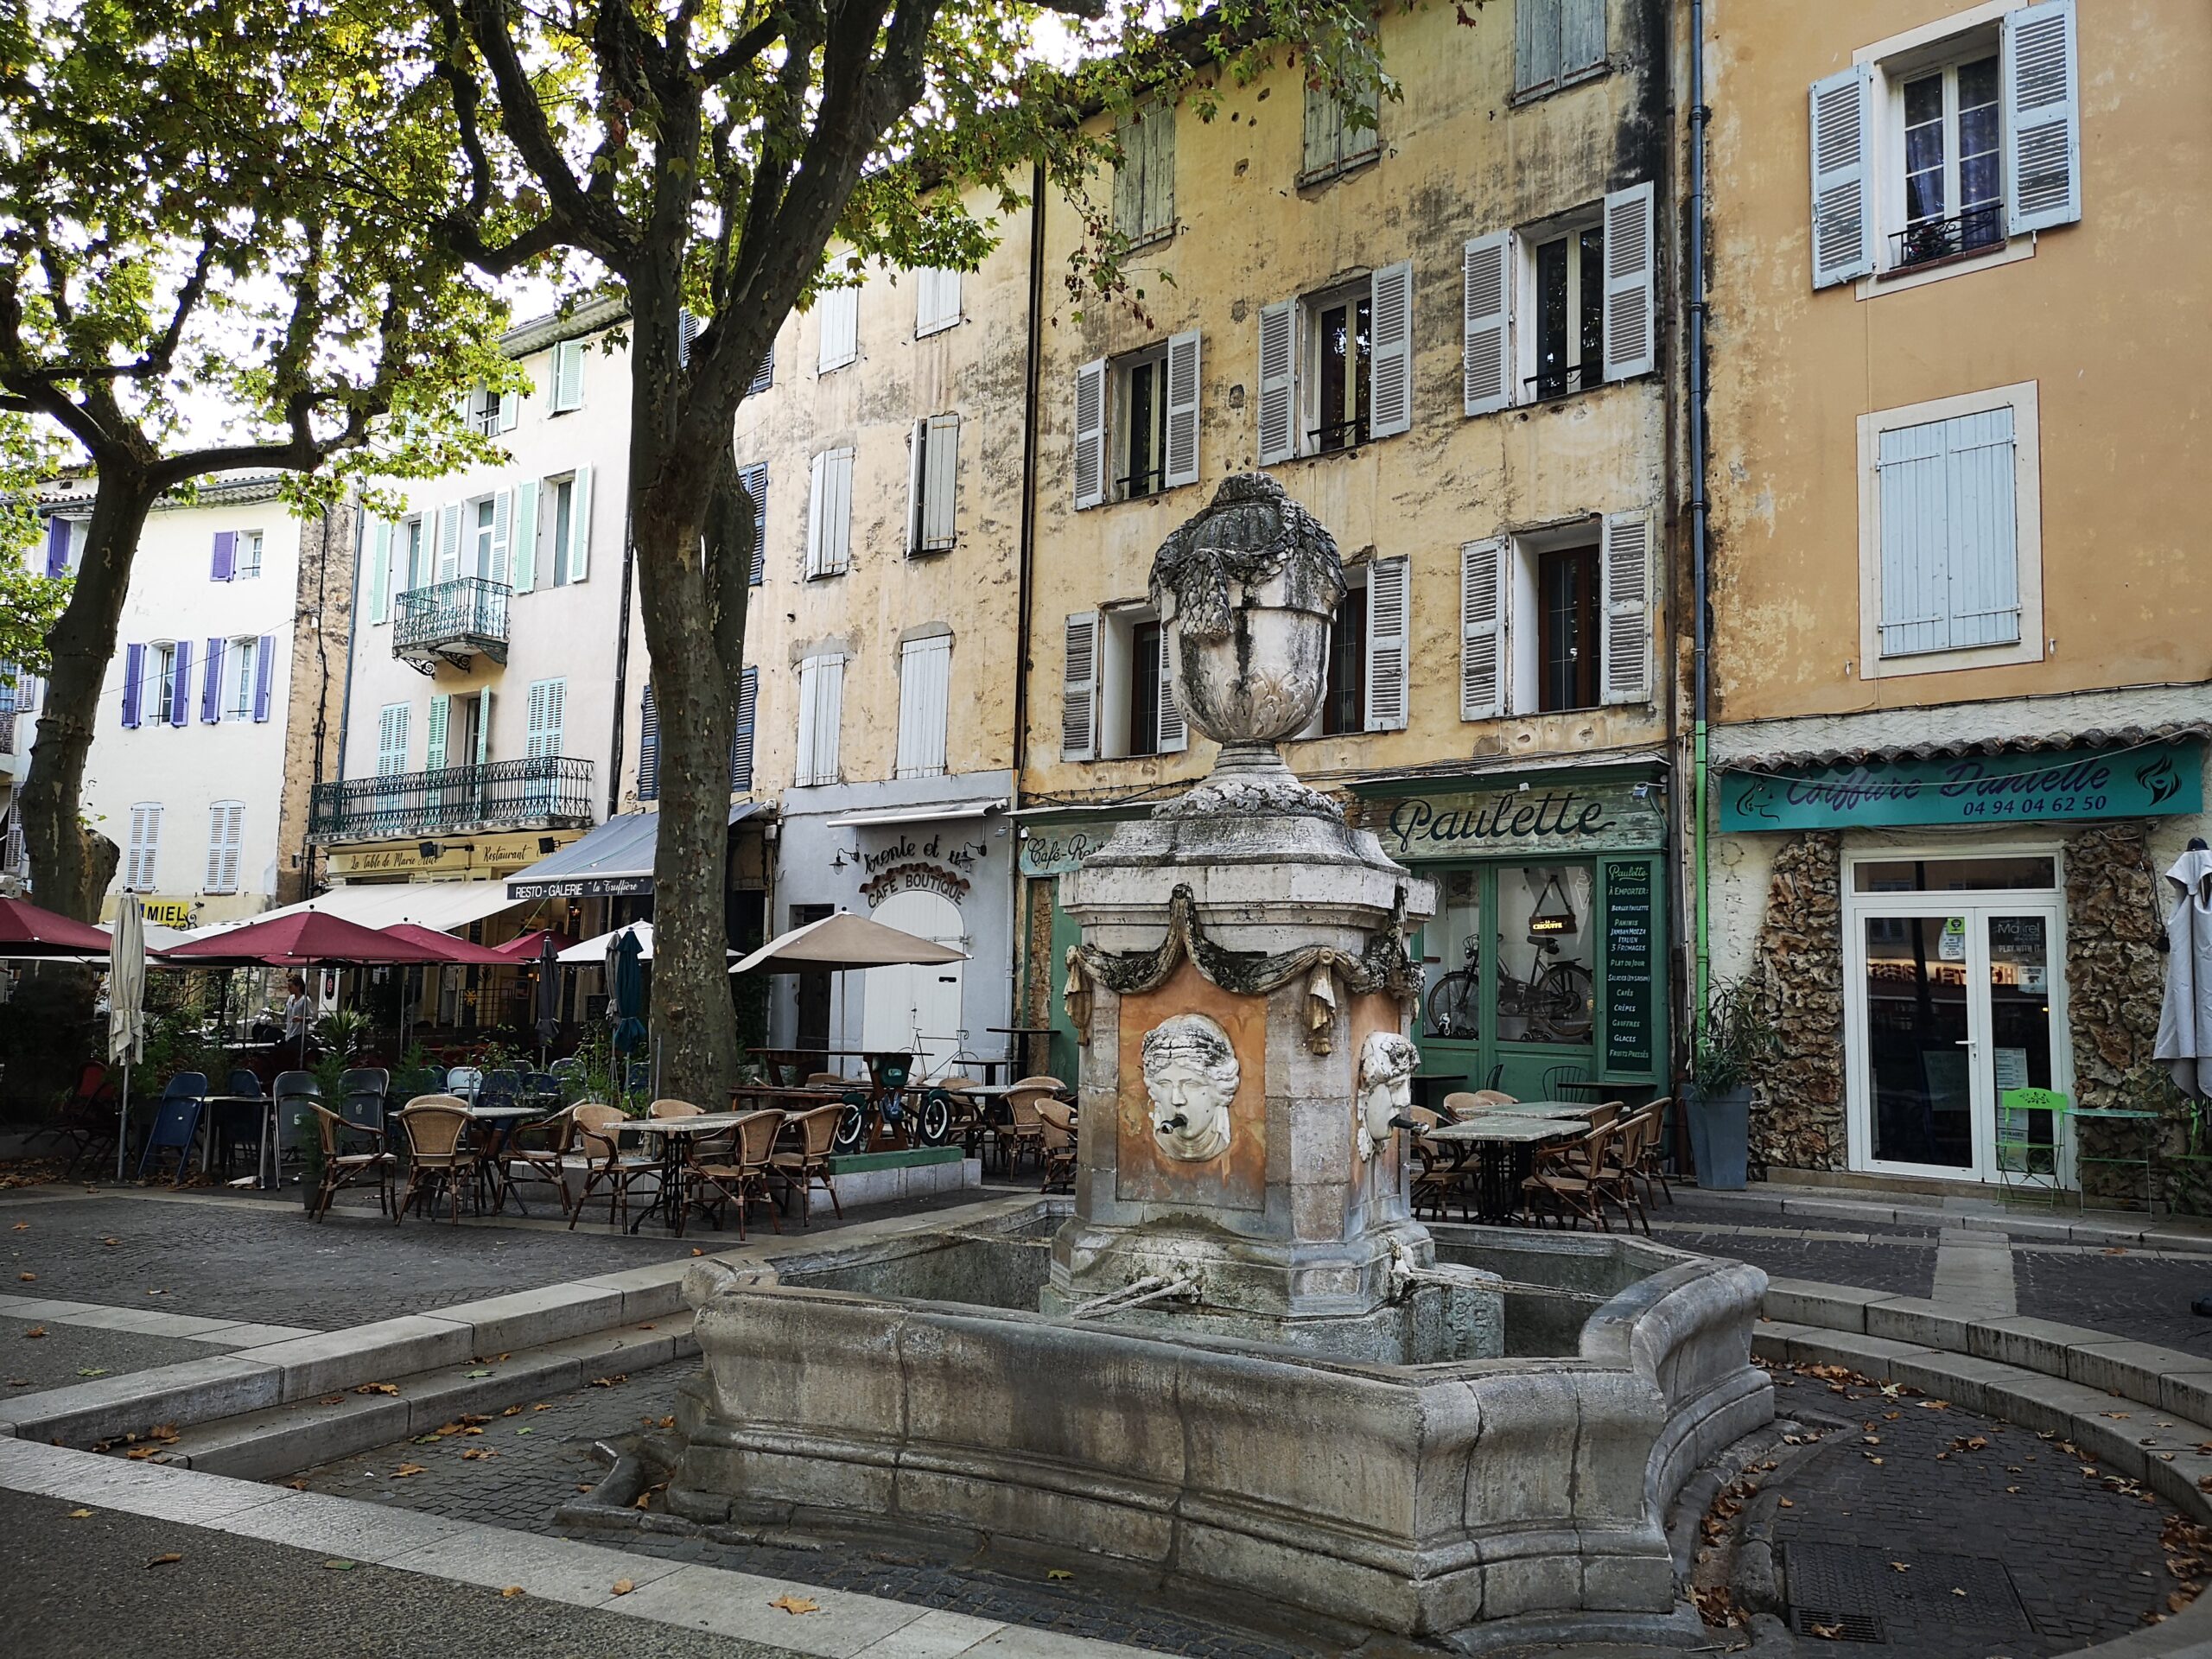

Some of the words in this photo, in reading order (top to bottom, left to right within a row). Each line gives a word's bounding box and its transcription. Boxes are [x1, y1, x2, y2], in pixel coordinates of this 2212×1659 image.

[1786, 771, 1923, 812] Coiffure
[1940, 759, 2111, 798] Danielle
[1963, 801, 1986, 817] 04
[1991, 799, 2015, 815] 94
[2021, 798, 2044, 814] 04
[2052, 797, 2075, 812] 62
[2082, 795, 2107, 810] 50
[1389, 791, 1617, 854] Paulette
[483, 845, 532, 862] Restaurant
[923, 834, 941, 858] et
[350, 855, 359, 869] La
[363, 854, 381, 869] Table
[381, 854, 390, 868] de
[393, 852, 416, 867] Marie
[1608, 864, 1649, 881] Paulette
[516, 886, 543, 899] RESTO
[548, 883, 583, 897] GALERIE
[906, 873, 966, 906] BOUTIQUE
[147, 906, 185, 921] MIEL
[2016, 944, 2032, 953] WITH
[1614, 1034, 1637, 1043] GLACES
